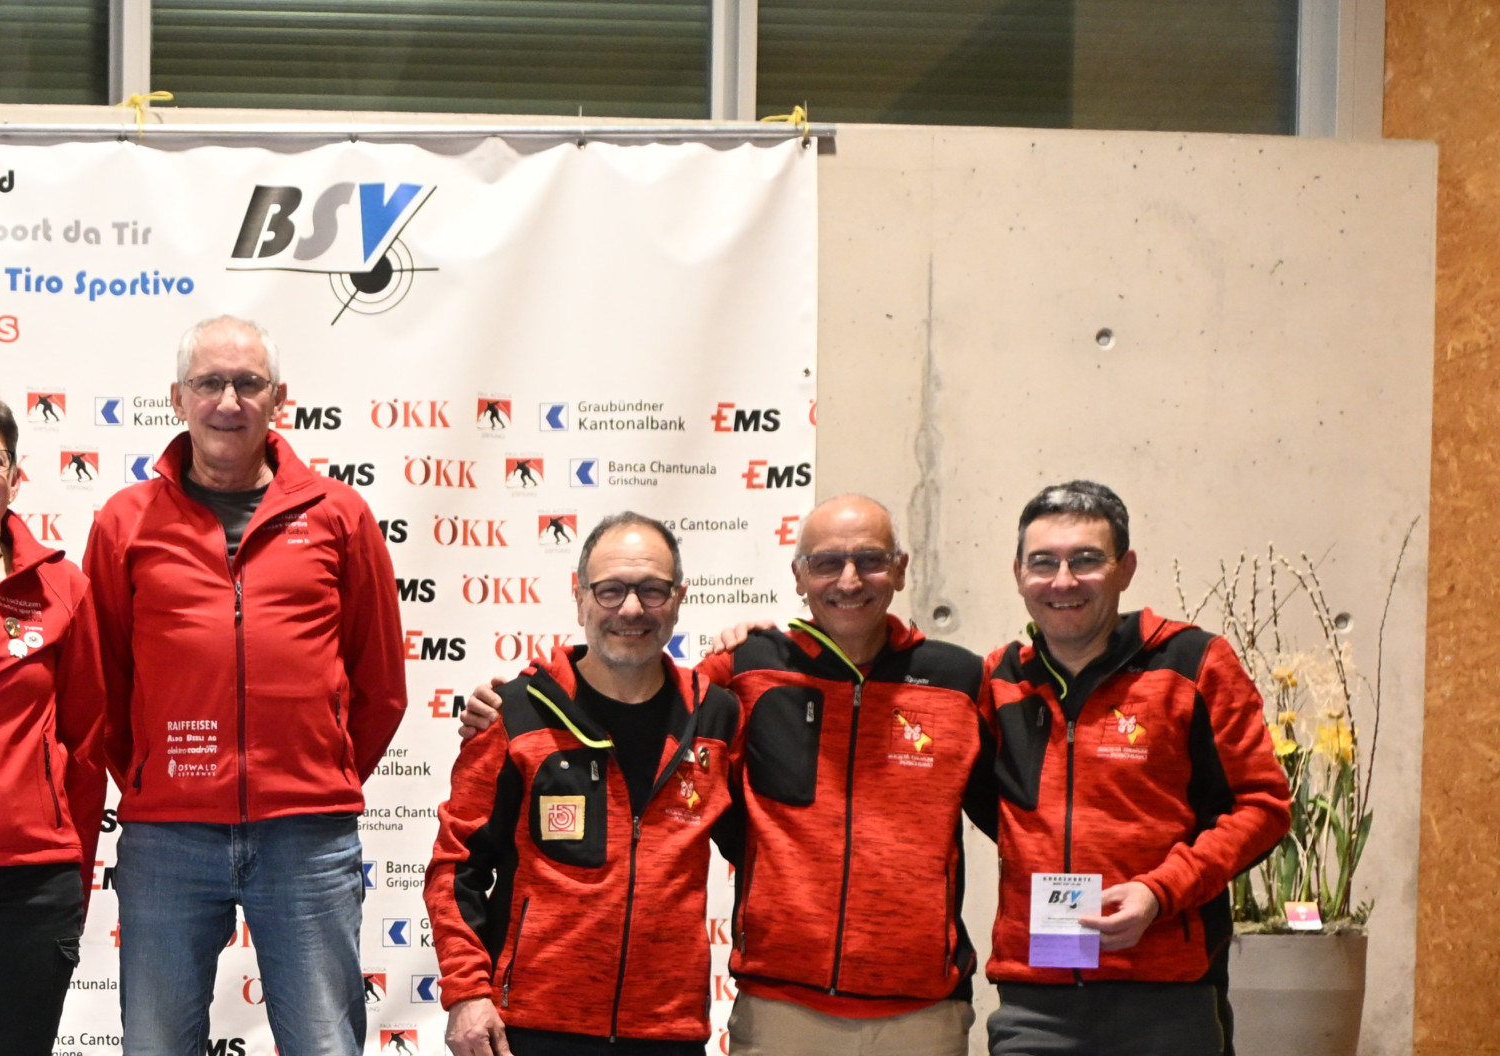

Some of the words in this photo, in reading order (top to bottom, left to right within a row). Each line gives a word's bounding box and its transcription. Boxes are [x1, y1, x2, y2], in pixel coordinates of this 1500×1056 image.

[63, 219, 102, 245] da
[112, 219, 152, 246] Tir
[230, 182, 423, 264] BSV
[4, 267, 64, 295] Tiro
[73, 268, 195, 302] Sportivo
[275, 400, 342, 430] EMS
[371, 398, 451, 429] ÖKK
[578, 400, 664, 412] Graubündner
[578, 416, 686, 431] Kantonalbank
[711, 402, 781, 432] EMS
[404, 455, 478, 489] ÖKK
[608, 461, 646, 473] Banca
[650, 461, 717, 475] Chantunala
[742, 460, 812, 489] EMS
[608, 476, 658, 486] Grischuna
[434, 514, 508, 547] ÖKK
[680, 518, 749, 531] Cantonale
[462, 574, 542, 604] ÖKK
[685, 574, 754, 586] aubündner
[395, 578, 436, 603] MS
[682, 588, 778, 604] antonalbank
[404, 630, 466, 661] EMS
[167, 720, 218, 731] RAIFFEISEN
[178, 764, 217, 772] OSWALD
[362, 809, 391, 818] anca
[386, 861, 425, 873] Banca
[1048, 890, 1082, 903] BSV
